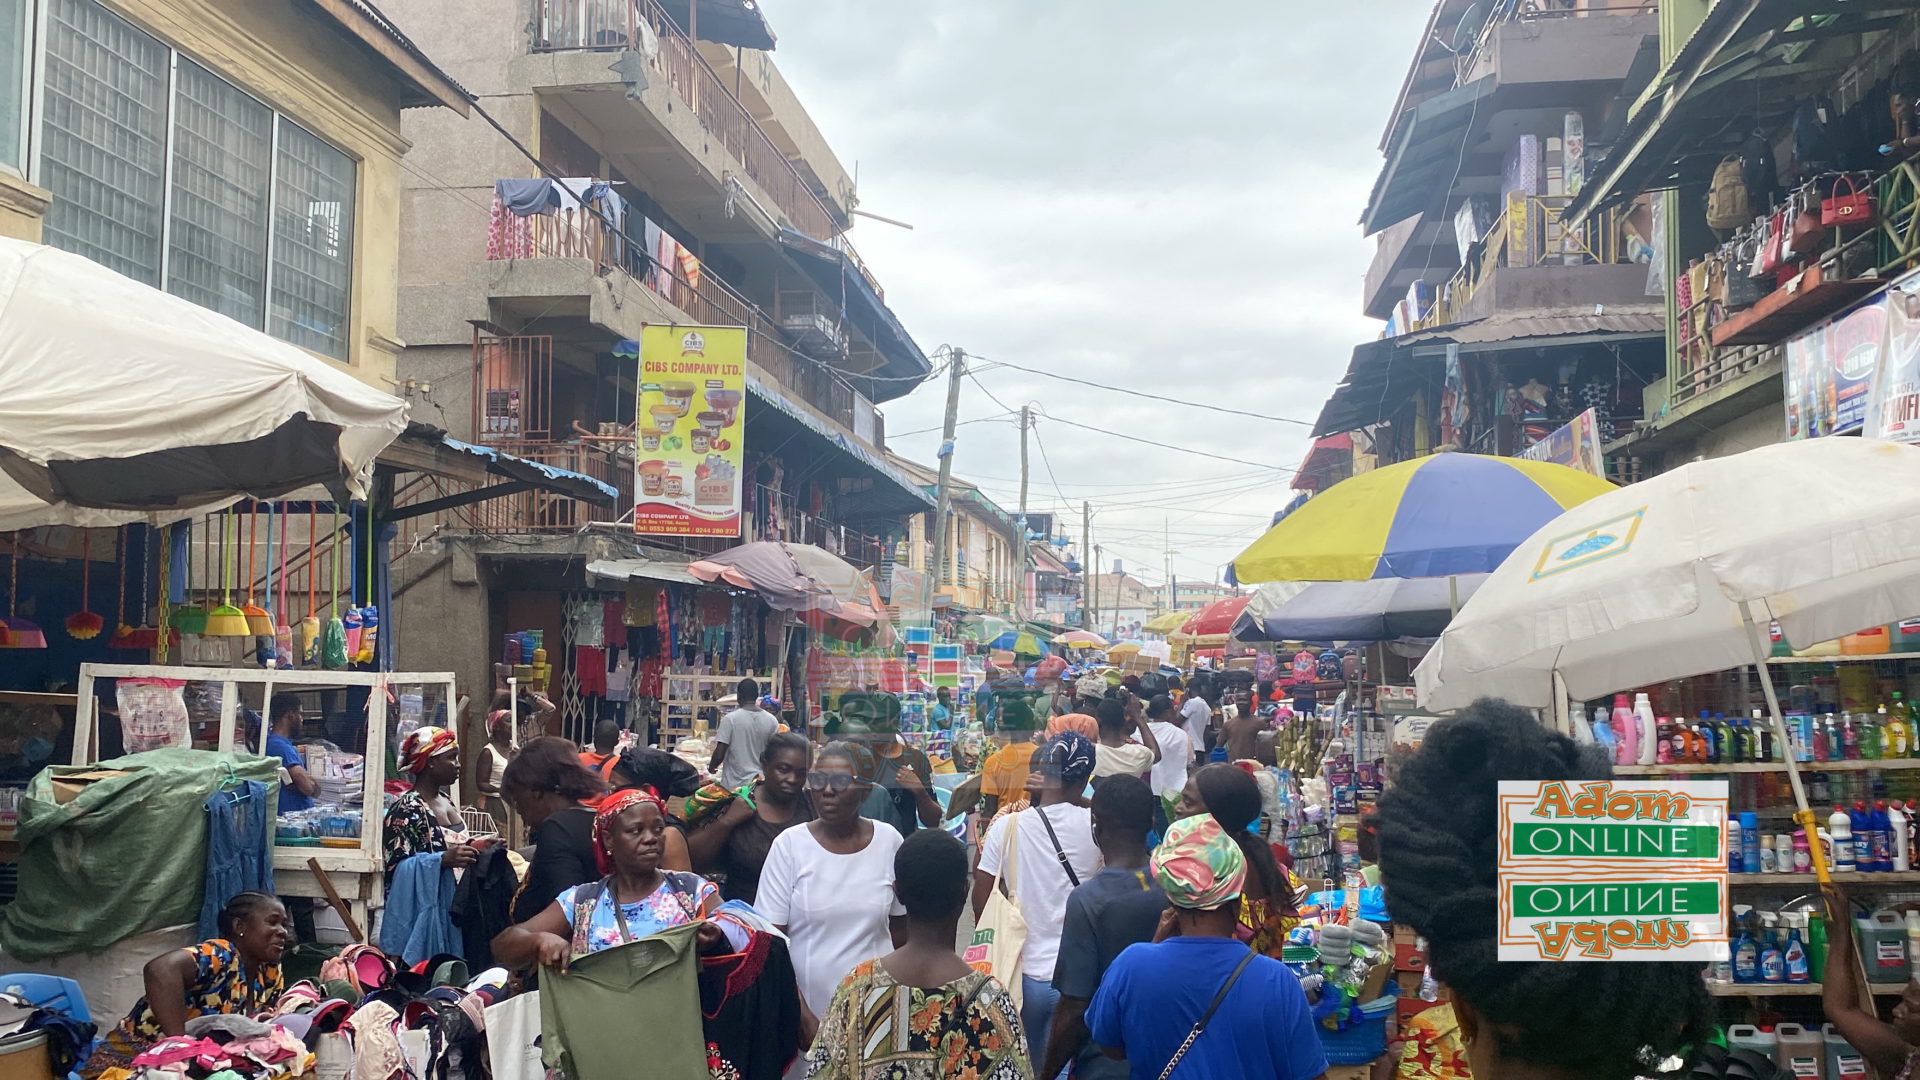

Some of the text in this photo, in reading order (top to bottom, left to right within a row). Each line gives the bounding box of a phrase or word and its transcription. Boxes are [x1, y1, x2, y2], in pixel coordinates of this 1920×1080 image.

[645, 361, 742, 376] CIBS COMPANY LTD.
[700, 485, 728, 493] CIBS
